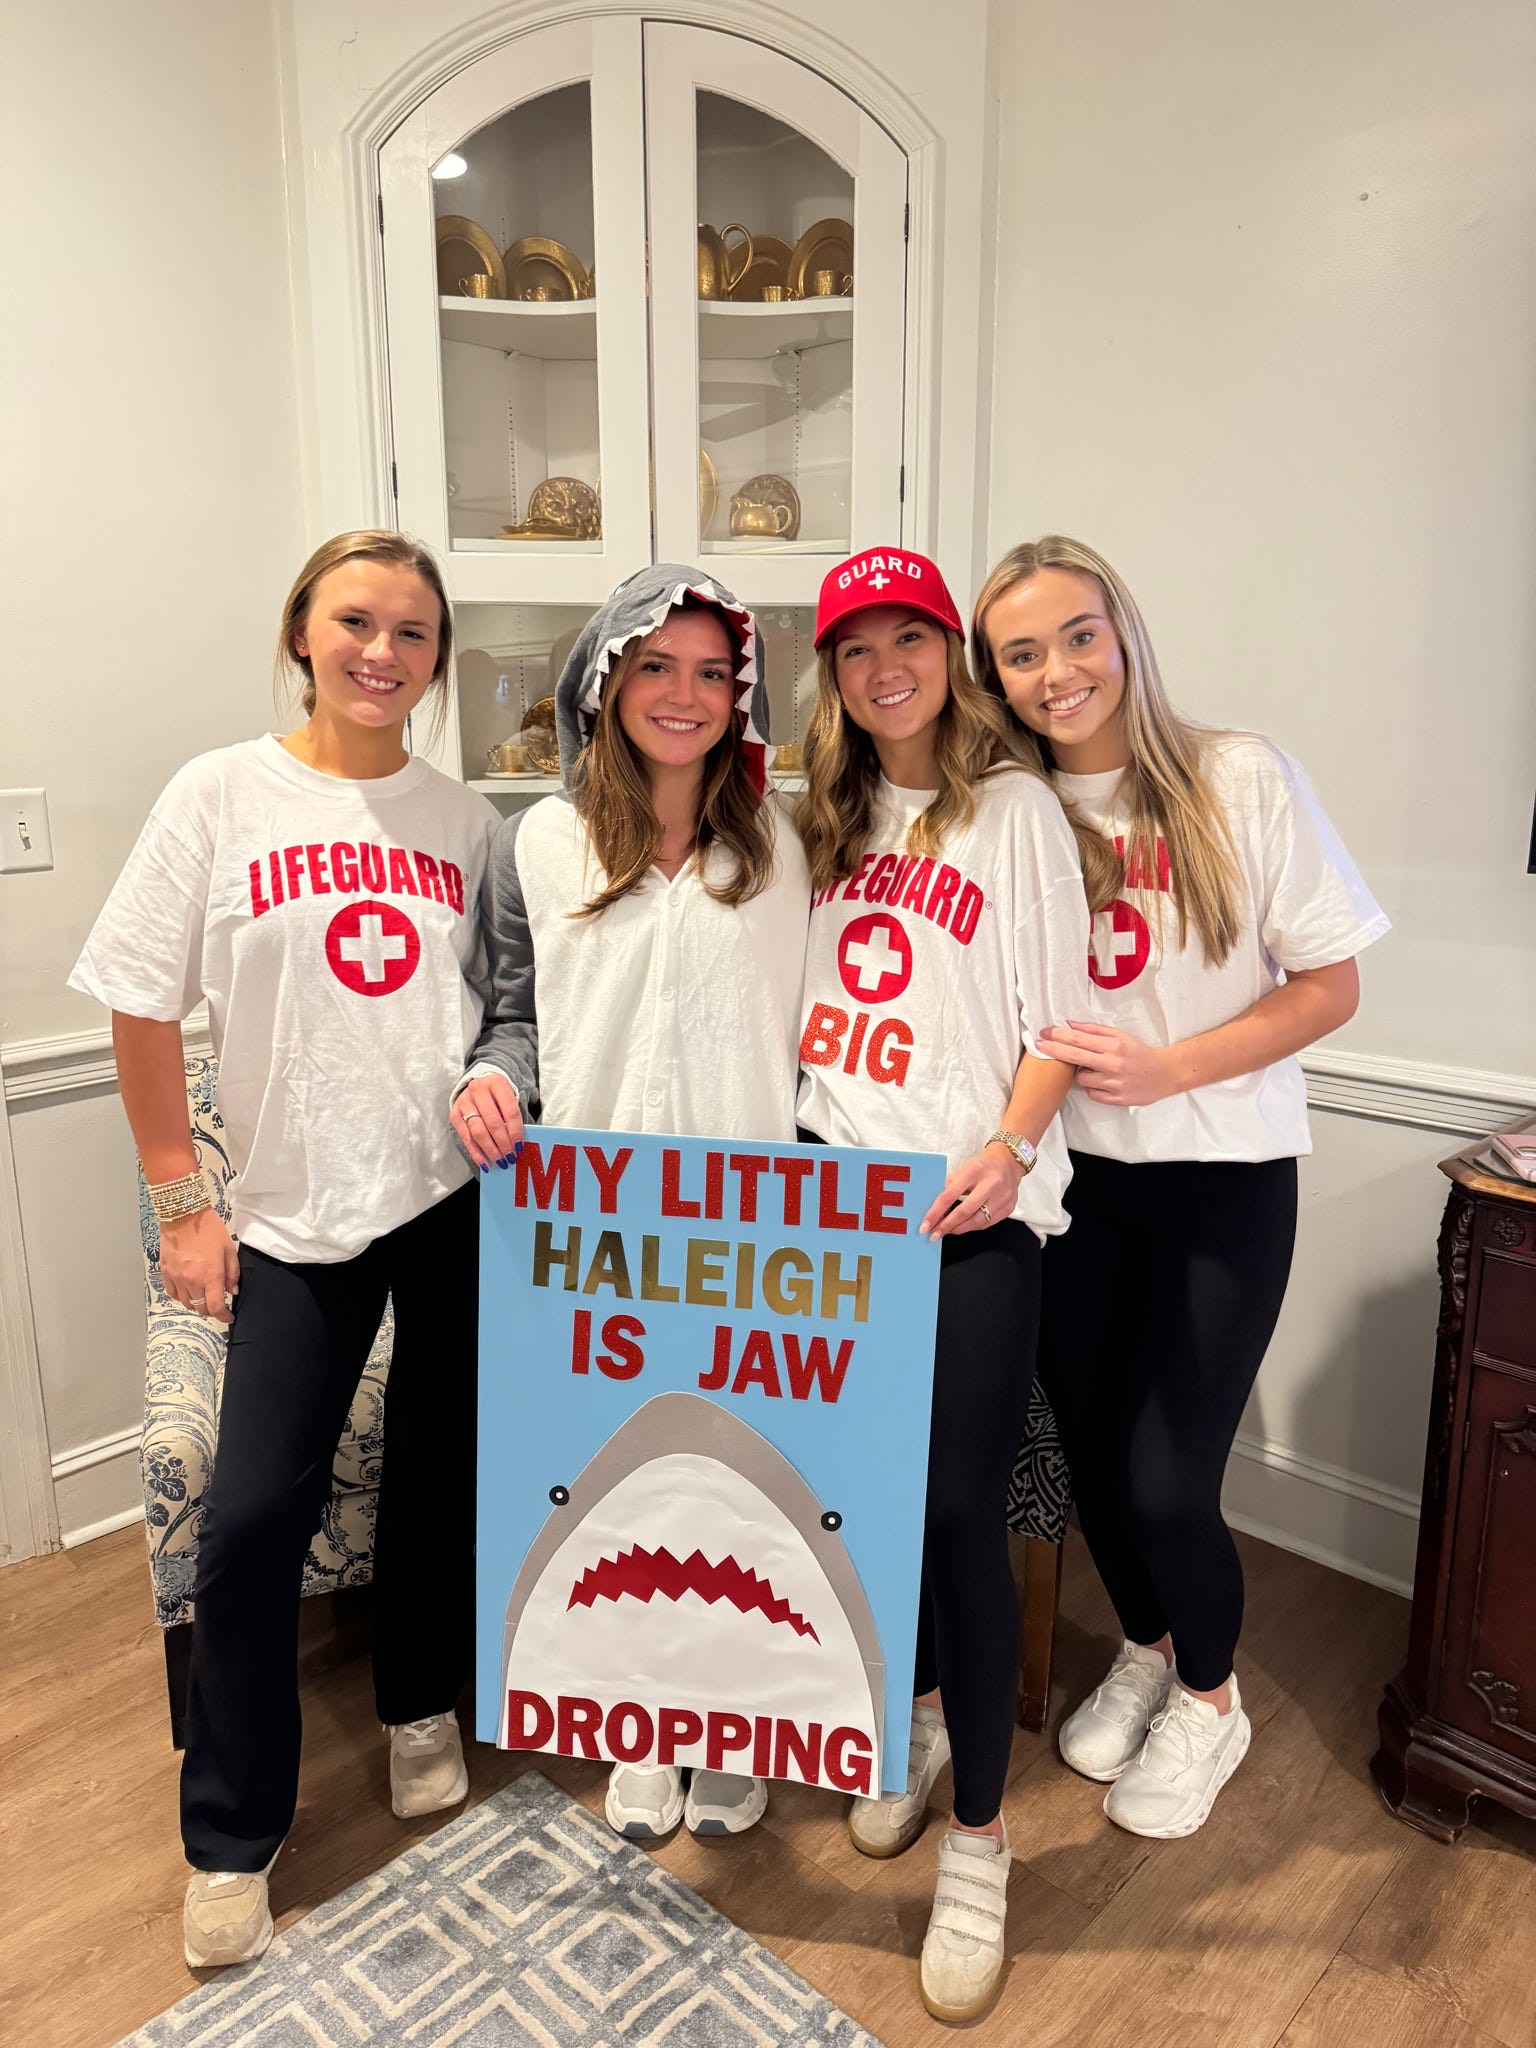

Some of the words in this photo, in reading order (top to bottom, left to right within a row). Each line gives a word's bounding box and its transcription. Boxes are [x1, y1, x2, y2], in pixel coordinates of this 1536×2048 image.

[838, 555, 922, 590] GUARD
[249, 841, 465, 919] LIFEGUARD
[809, 852, 985, 946] FEGUARD
[799, 1001, 914, 1087] BIG
[514, 1141, 634, 1214] MY
[661, 1148, 911, 1234] LITTLE
[532, 1220, 872, 1322] HALEIGH
[571, 1308, 646, 1381] IS
[698, 1325, 855, 1403] JAW
[507, 1689, 873, 1795] DROPPING
